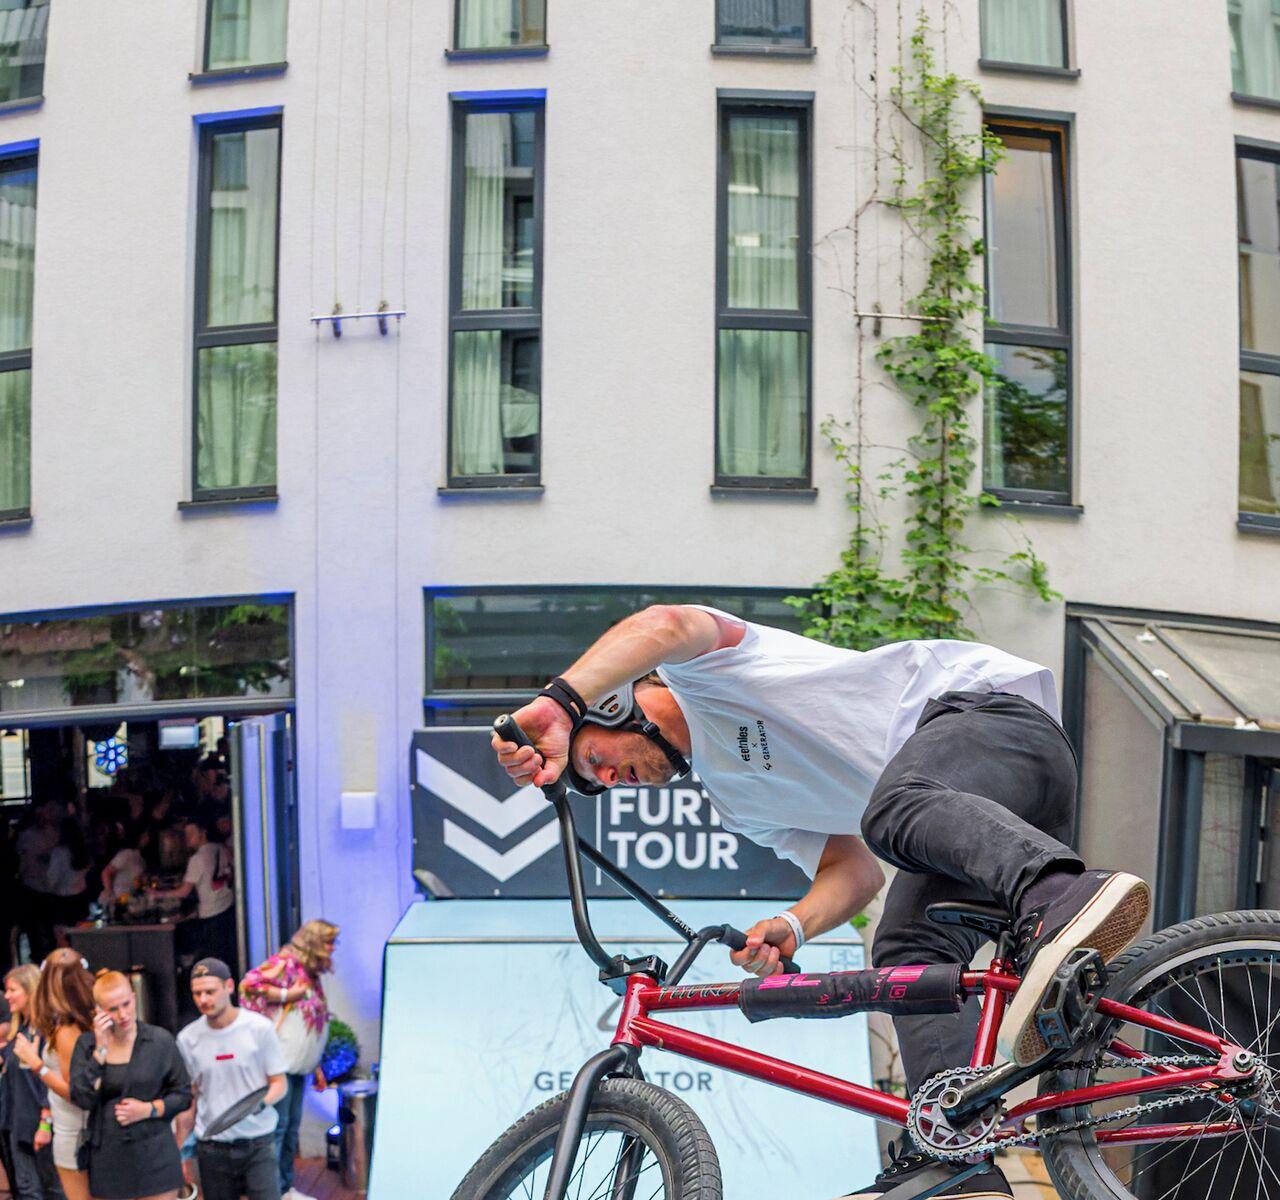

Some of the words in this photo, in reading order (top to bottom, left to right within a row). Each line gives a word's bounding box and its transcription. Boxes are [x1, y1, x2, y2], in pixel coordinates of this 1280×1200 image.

[756, 719, 771, 761] GENERATOR
[607, 831, 739, 870] TOUR
[533, 1070, 713, 1093] GETOR
